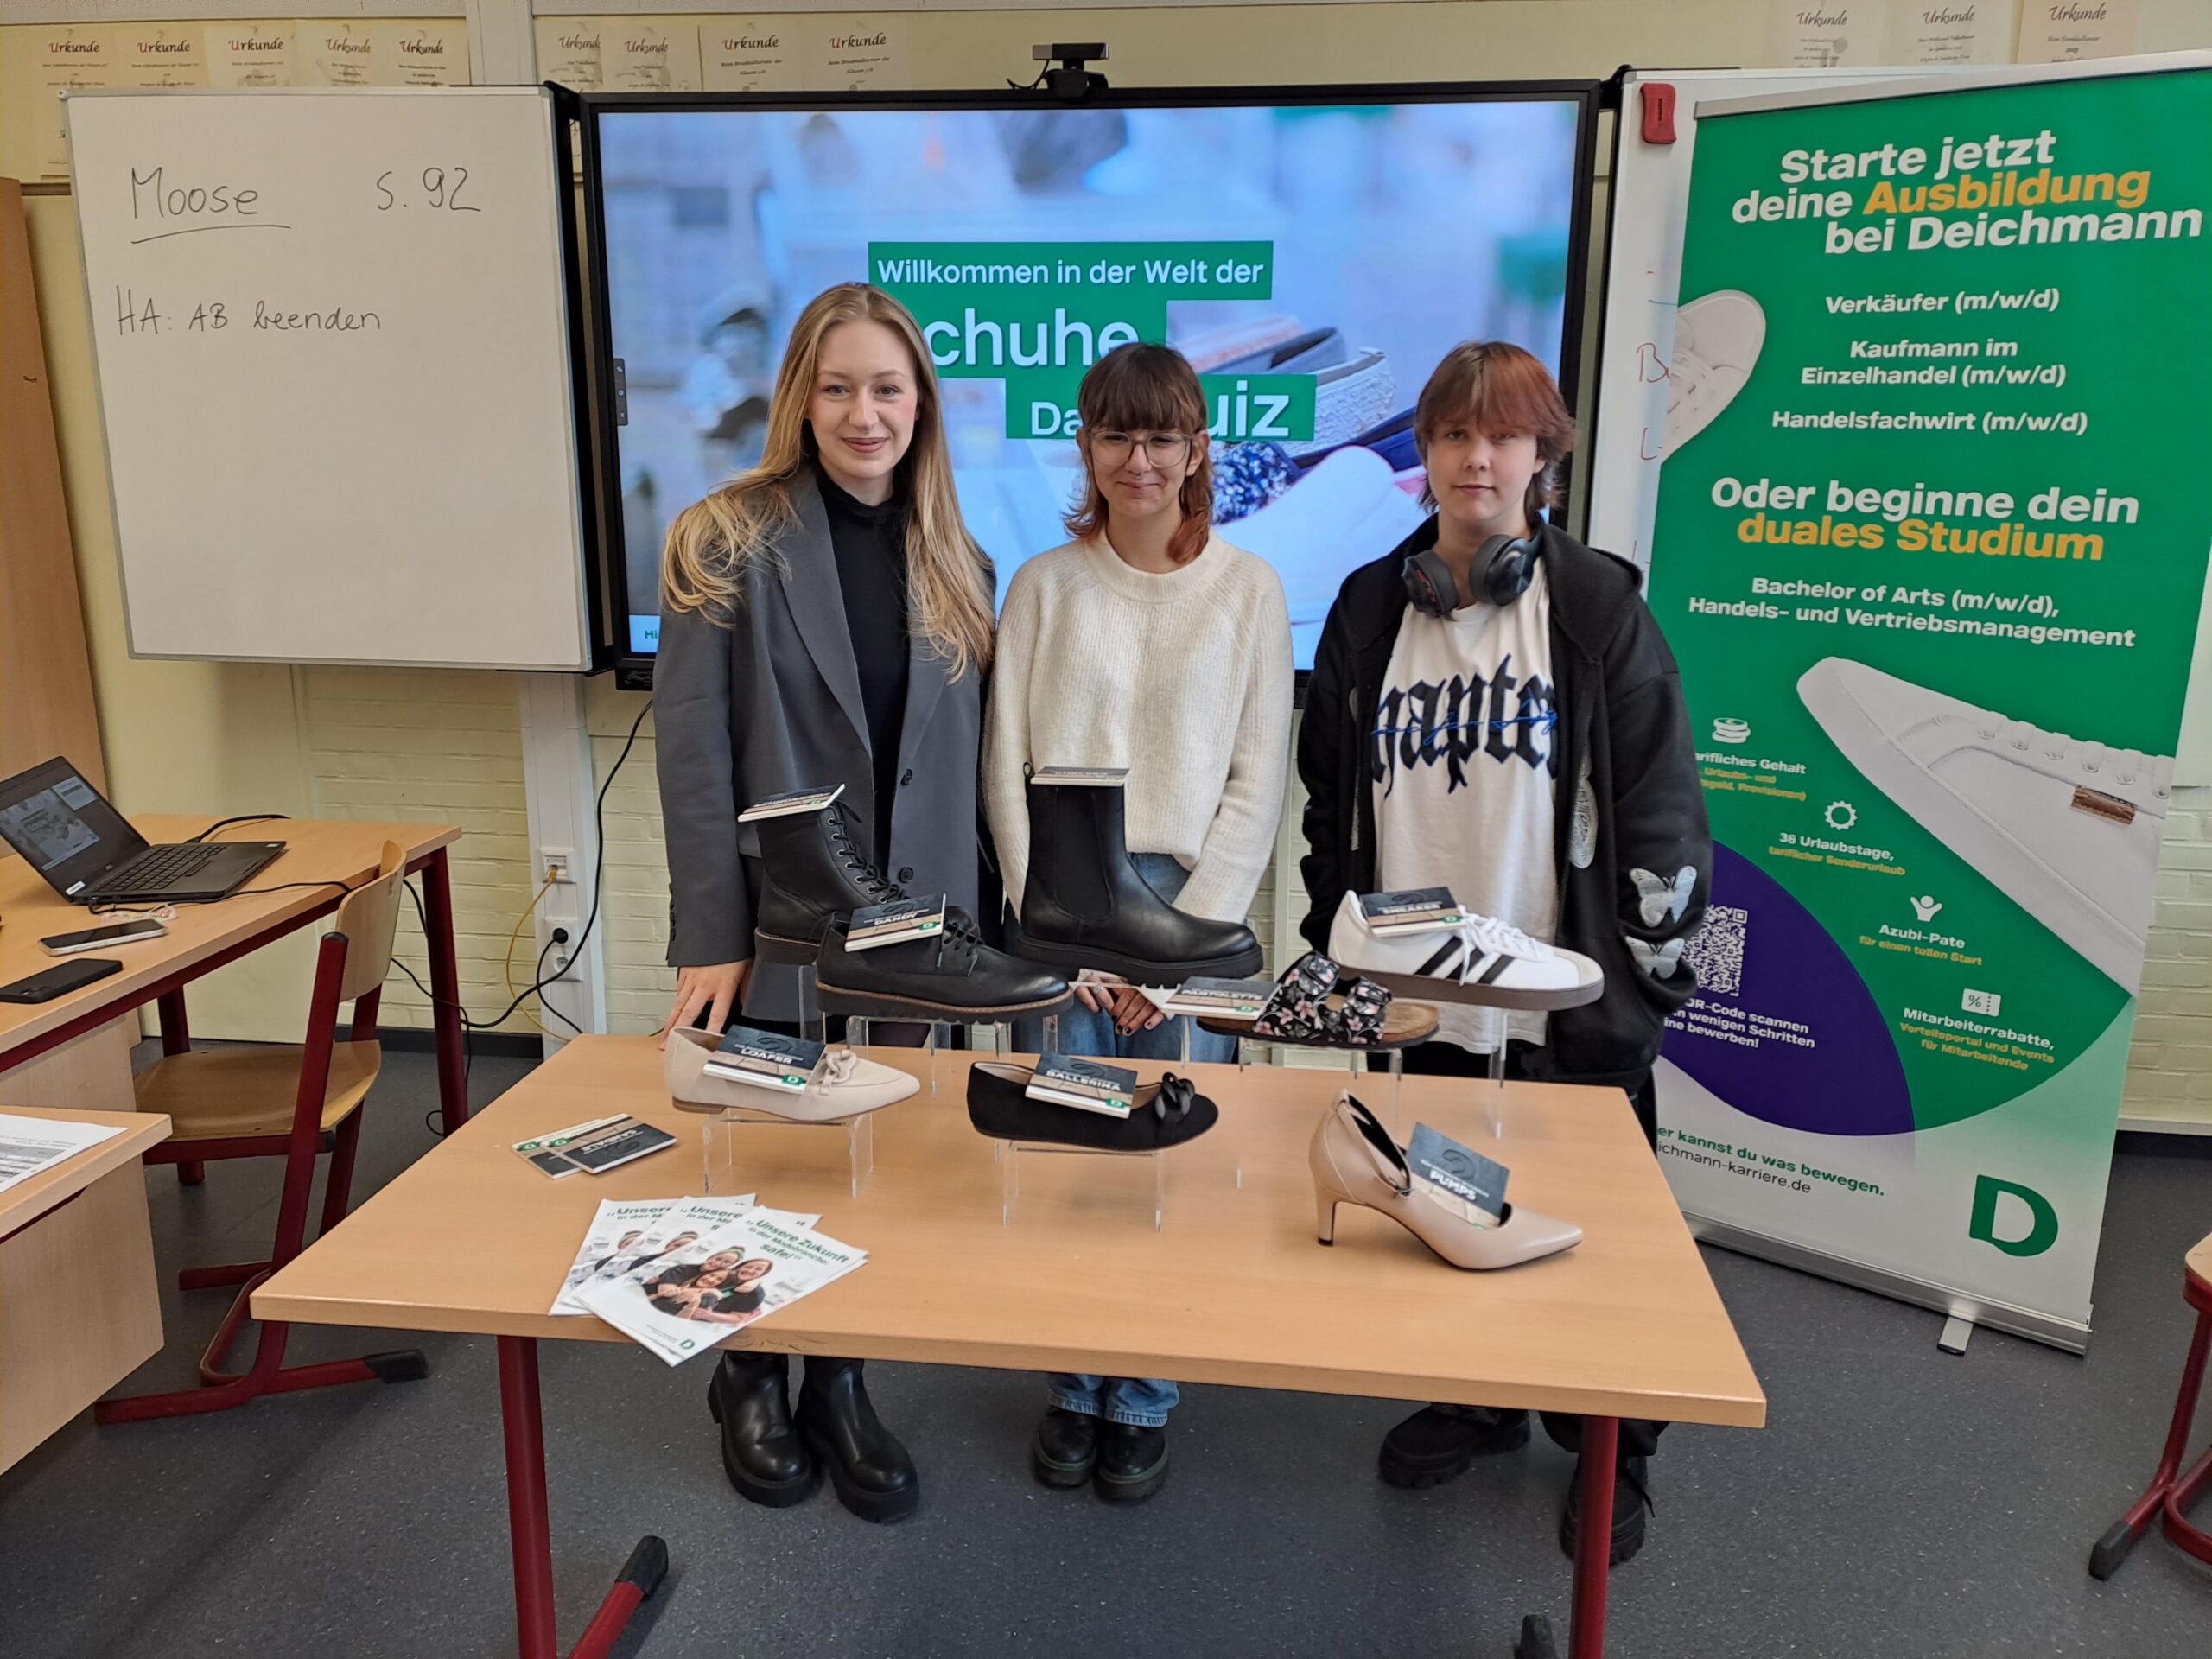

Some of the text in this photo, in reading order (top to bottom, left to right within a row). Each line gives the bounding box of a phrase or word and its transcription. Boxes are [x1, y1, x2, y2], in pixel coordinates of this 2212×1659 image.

[1797, 11, 1847, 27] Urkunde
[1923, 5, 1975, 25] Urkunde
[2049, 1, 2106, 22] Urkunde
[49, 40, 100, 54] Urkunde
[137, 40, 190, 54] Urkunde
[228, 37, 283, 51] Urkunde
[325, 38, 371, 54] Urkunde
[399, 39, 443, 55] Urkunde
[624, 37, 669, 54] Urkunde
[721, 34, 779, 52] Urkunde
[830, 32, 887, 50] Urkunde
[1780, 129, 2057, 184] Starte jetzt
[131, 166, 259, 219] Moose
[423, 166, 481, 213] 92
[1732, 168, 2151, 224] deine Ausbildung
[1824, 207, 2203, 255] bei Deichmann
[877, 257, 1264, 284] Willkommen in der Welt der
[116, 284, 381, 336] HA: AB beenden
[1825, 287, 2060, 315] Verkäufer (m/w/d)
[923, 307, 1139, 367] chuhe
[1850, 338, 2018, 359] Kaufmann im
[1801, 363, 2067, 388] Einzelhandel (m/w/d)
[1031, 400, 1084, 436] Da
[1206, 378, 1290, 437] uiz
[1771, 410, 2088, 435] Handelsfachwirt (m/w/d)
[1711, 476, 2139, 524] Oder beginne dein
[1737, 512, 2105, 561] duales Studium
[1751, 576, 2060, 619] Bachelor of Arts (m/w/d),
[645, 629, 658, 640] Hi
[1688, 596, 2136, 648] Handels- und Vertriebsmanagement
[1759, 758, 1807, 775] Gehalt
[1779, 832, 1895, 861] 36 Urlaubstage,
[874, 911, 918, 926] DANDY
[1859, 935, 1982, 966] für einen tollen Start
[1878, 924, 1966, 950] Azubi-Pate
[1663, 1016, 1760, 1048] ine bewerben!
[1688, 1010, 1746, 1033] wenigen
[1748, 1024, 1816, 1049] Schritten
[1748, 1012, 1809, 1034] scannen
[1903, 1007, 2056, 1052] Mitarbeiterrabatte,
[740, 1047, 793, 1065] LOAFER
[1900, 1021, 2056, 1065] Vorteilsportal und Events
[1920, 1039, 2029, 1071] für Mitarbeitende
[1046, 1069, 1122, 1092] BALLERINA
[1658, 1126, 1885, 1197] er kannst du was bewegen.
[1658, 1140, 1812, 1194] ichmann-karriere.de
[1429, 1168, 1478, 1201] PUMPS
[1968, 1173, 2059, 1258] D
[799, 1238, 849, 1263] Zukunft
